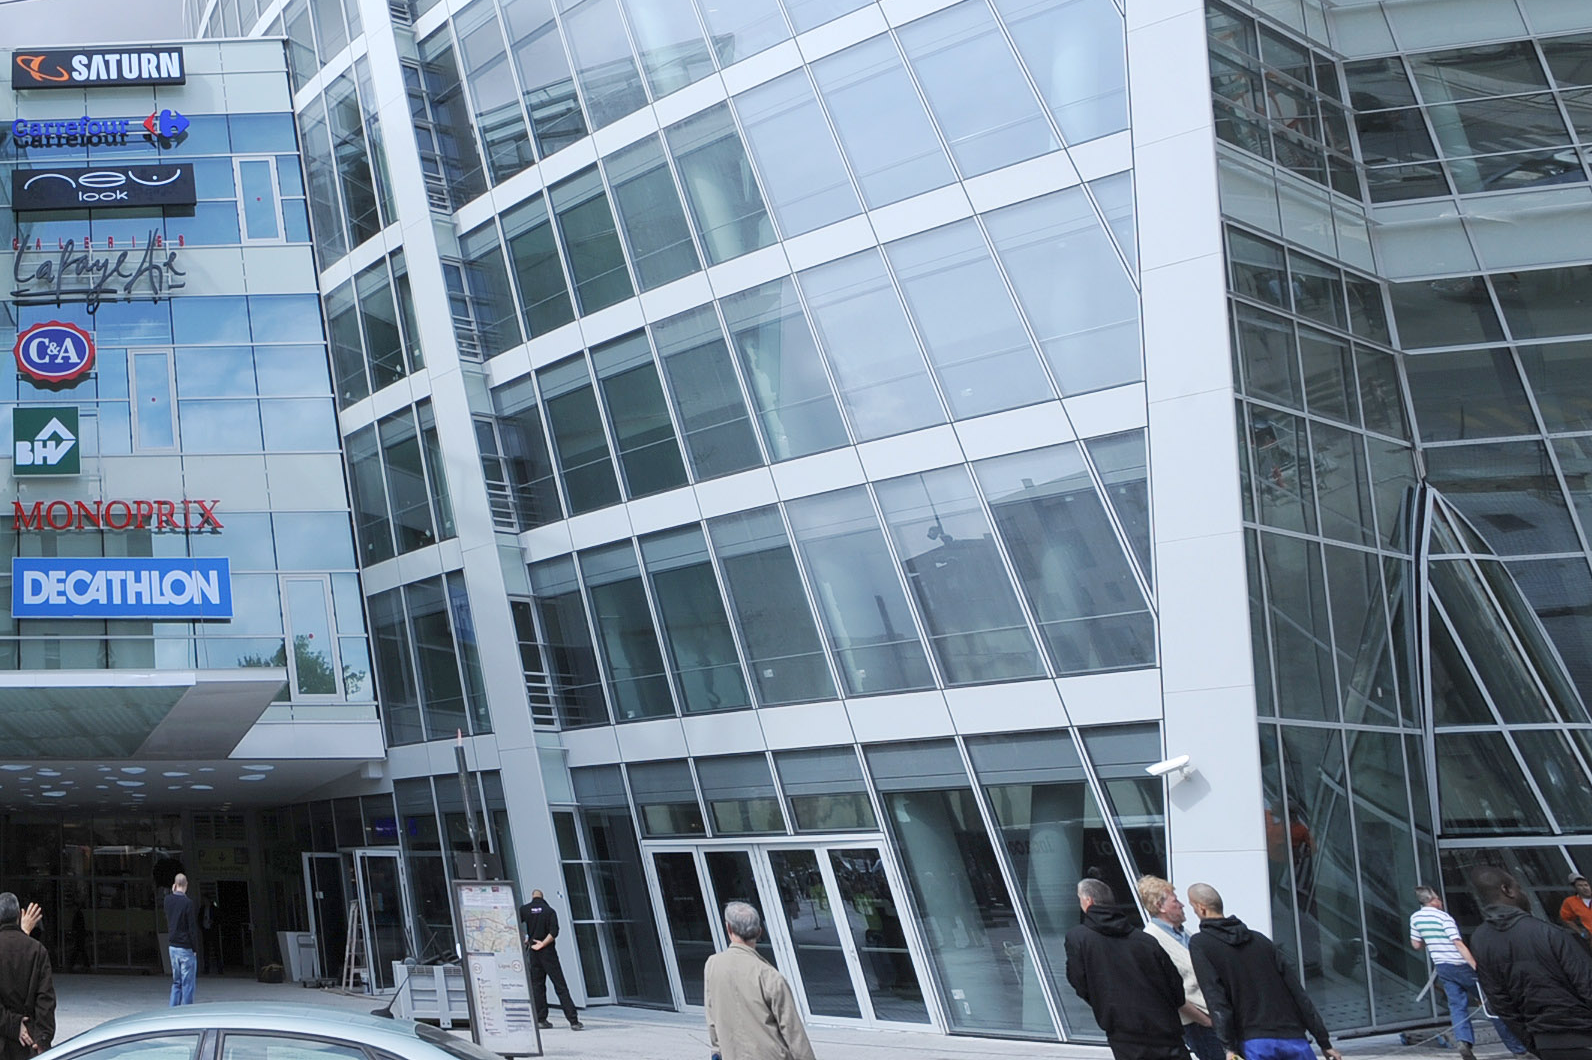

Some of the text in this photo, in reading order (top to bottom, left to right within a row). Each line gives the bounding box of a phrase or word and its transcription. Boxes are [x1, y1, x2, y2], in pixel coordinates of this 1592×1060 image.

[72, 52, 181, 81] SATURN
[12, 116, 129, 138] Carrefour
[79, 190, 128, 201] look
[12, 235, 185, 250] GALERIES
[28, 337, 81, 363] C&A
[16, 440, 77, 465] BHV
[11, 500, 224, 530] MONOPRIX
[23, 569, 221, 605] DECATHLON
